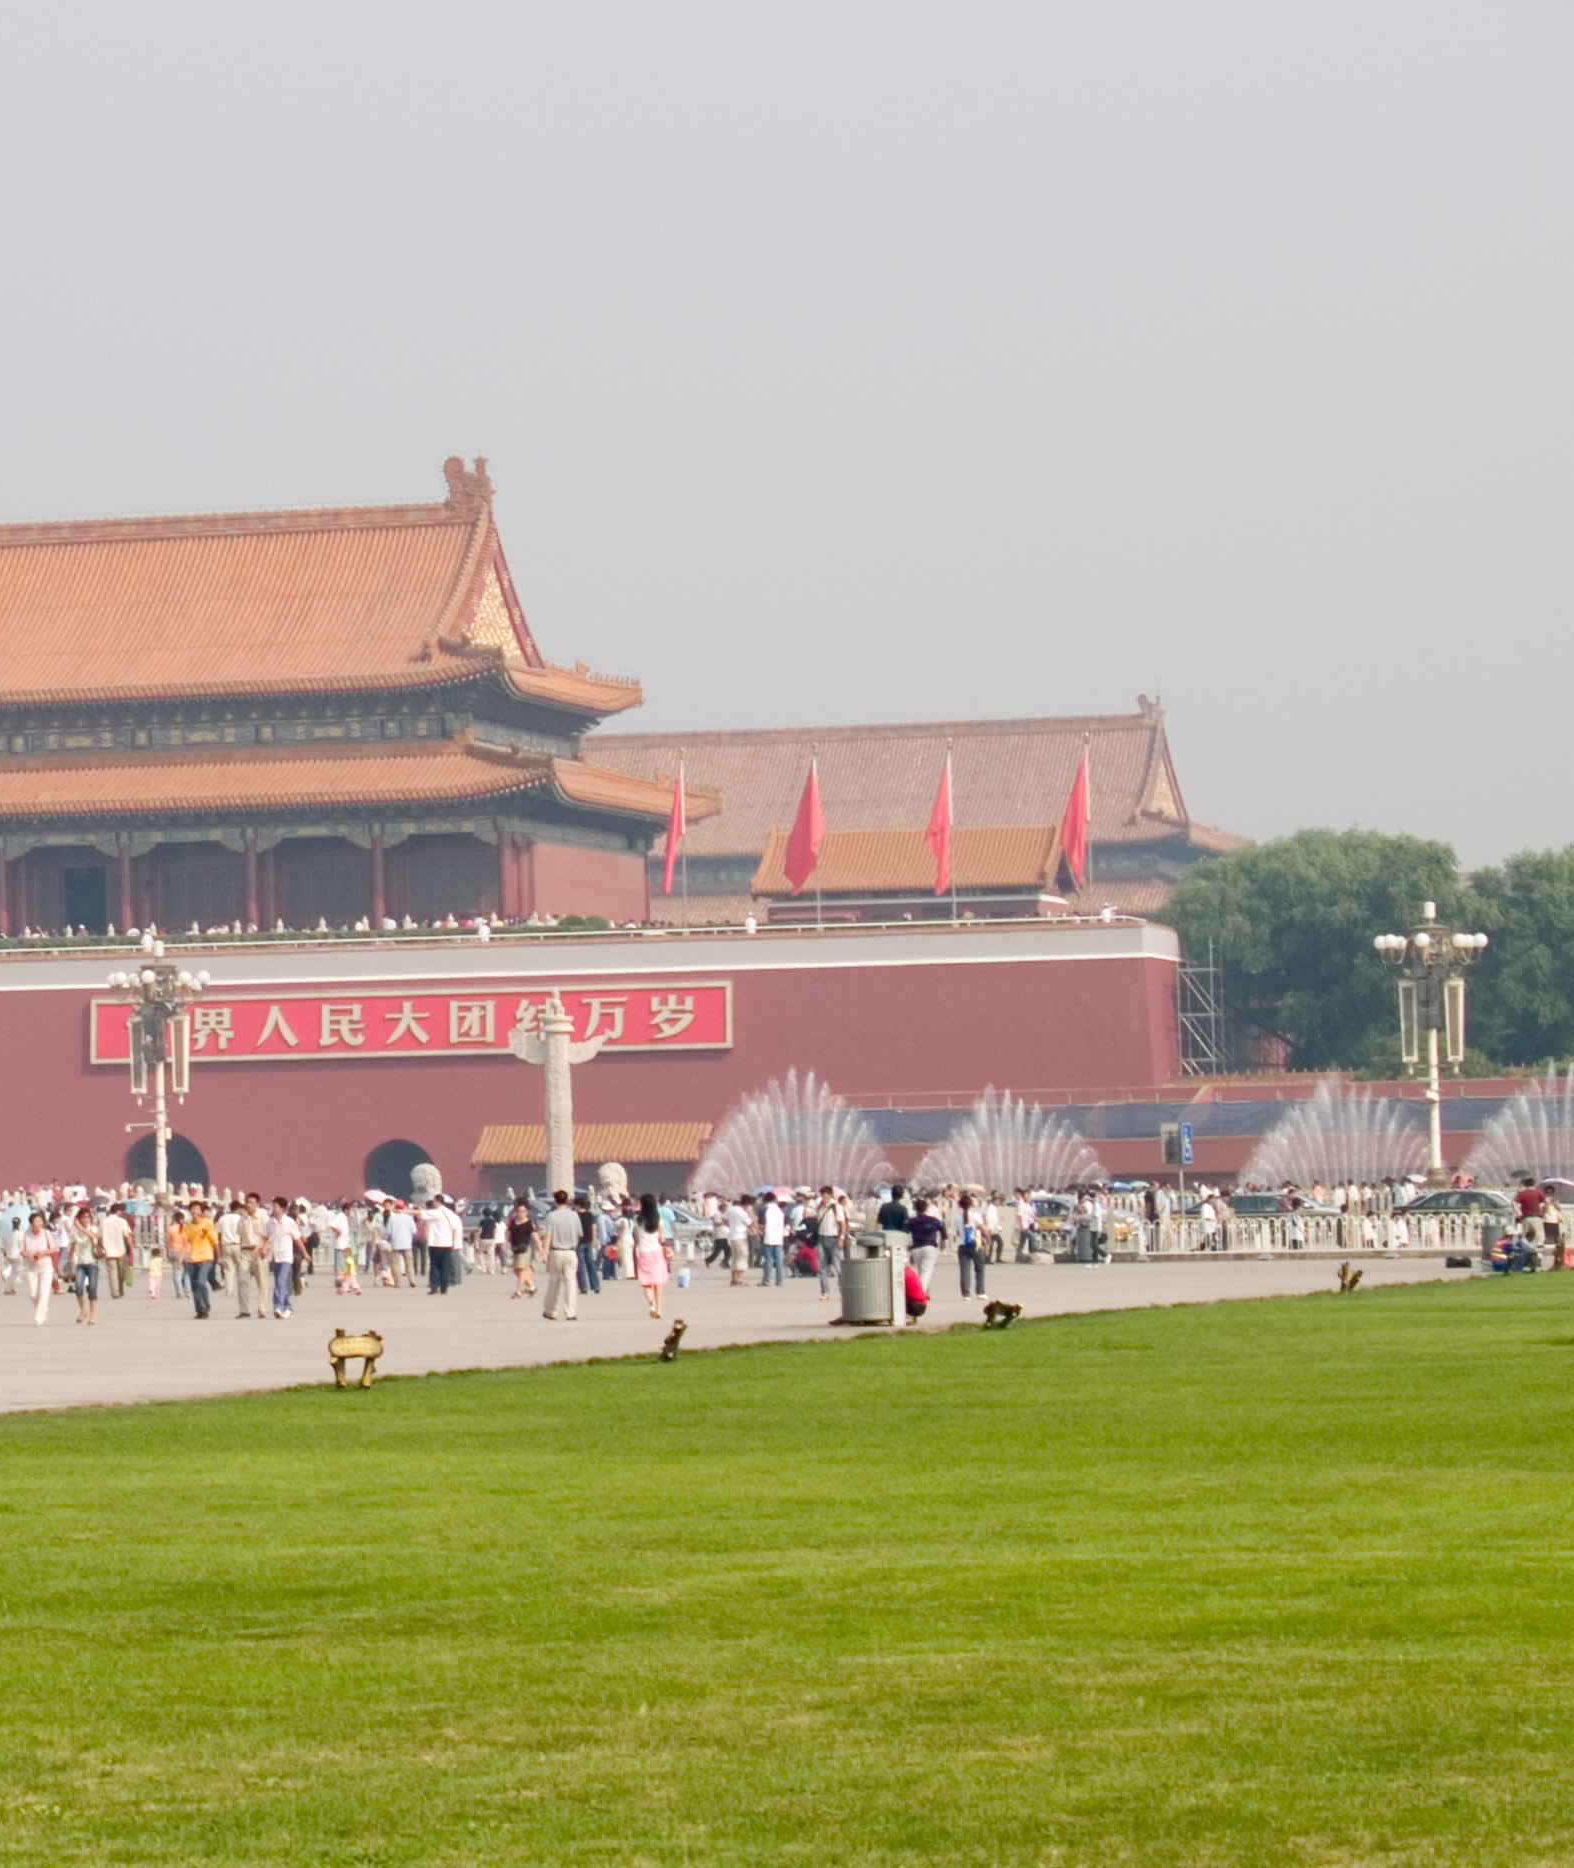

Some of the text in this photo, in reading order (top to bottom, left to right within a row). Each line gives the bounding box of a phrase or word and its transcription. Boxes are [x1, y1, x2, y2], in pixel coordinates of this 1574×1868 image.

[127, 993, 695, 1052] 界人民大团万岁
